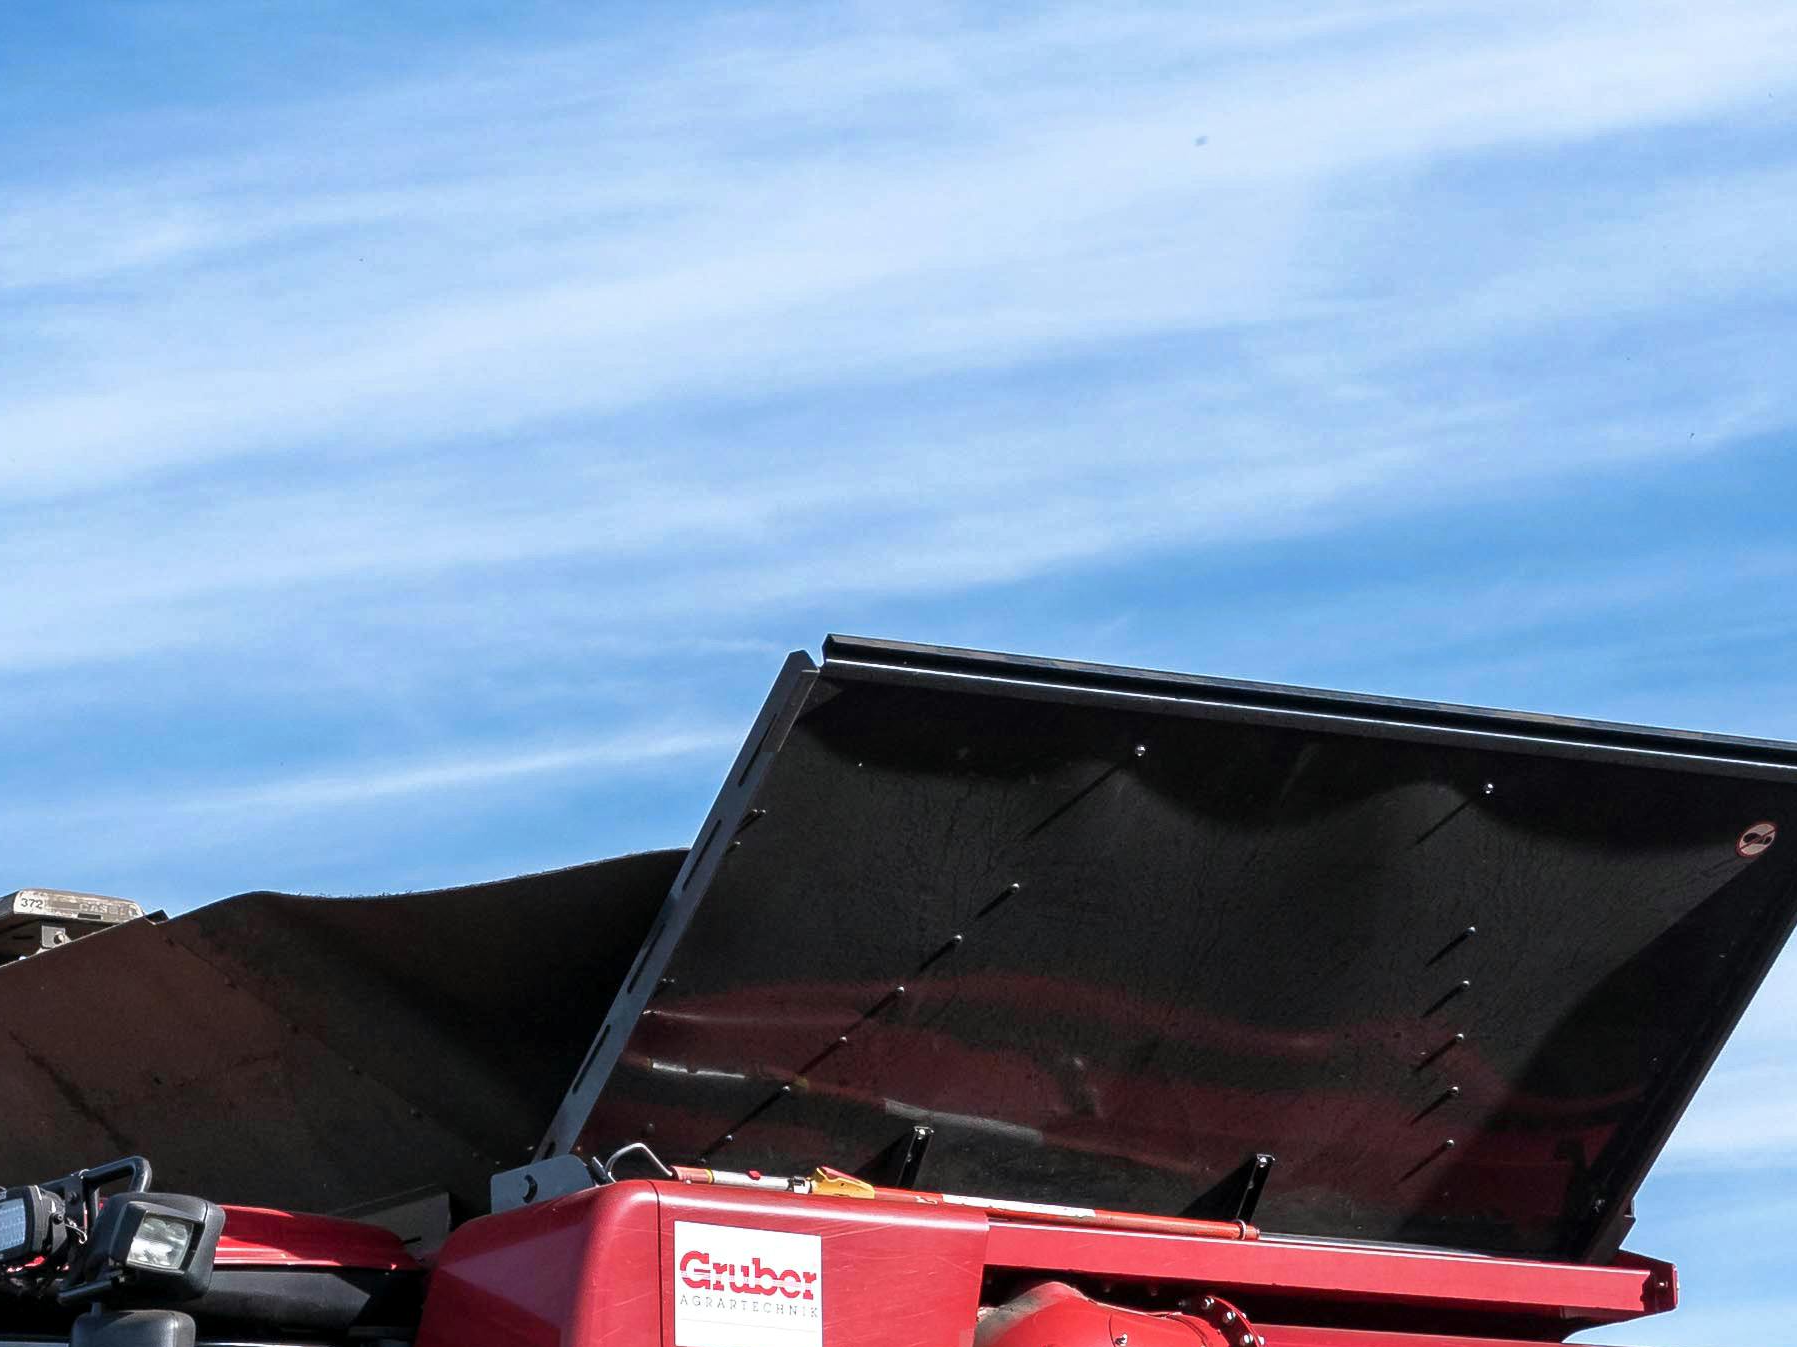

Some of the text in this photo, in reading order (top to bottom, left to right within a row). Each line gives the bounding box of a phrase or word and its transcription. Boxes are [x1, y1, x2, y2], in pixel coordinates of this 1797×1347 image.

[20, 897, 44, 910] 372
[679, 1250, 817, 1300] Gruber
[680, 1294, 819, 1318] AGRARTECHNIK
